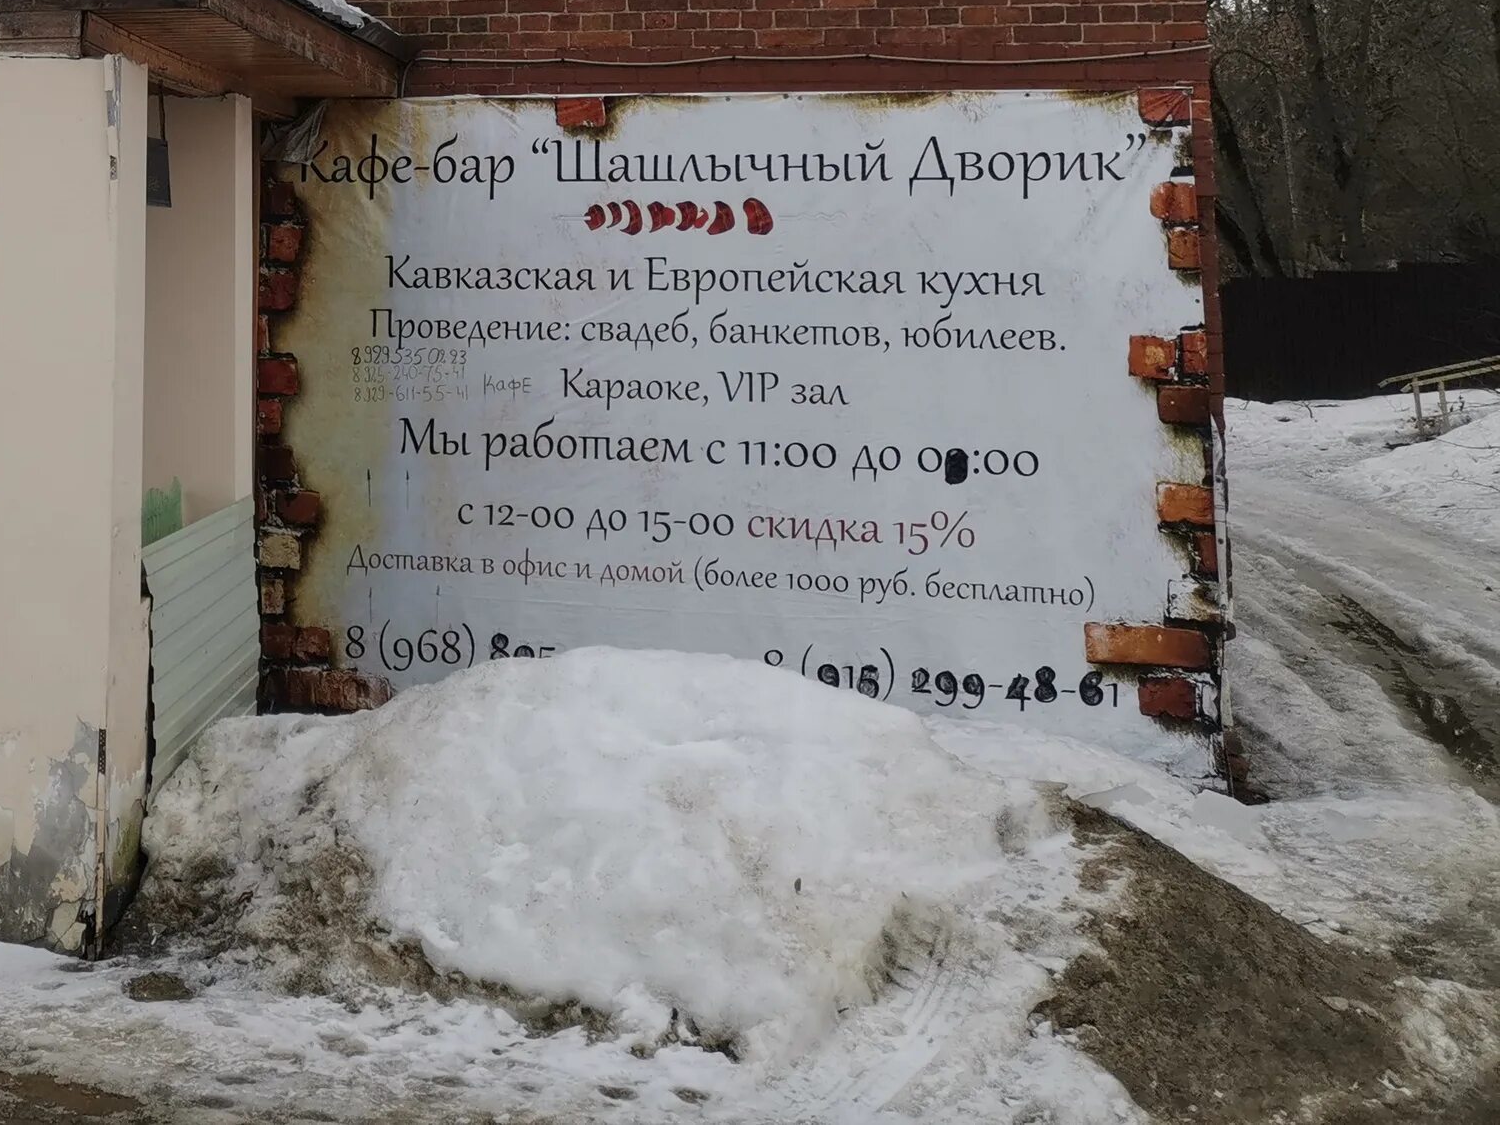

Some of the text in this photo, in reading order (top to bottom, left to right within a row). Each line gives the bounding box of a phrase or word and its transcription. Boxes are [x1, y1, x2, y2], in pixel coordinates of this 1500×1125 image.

[301, 132, 1147, 200] Кафе-бар “Шашлычный Дворик”
[385, 255, 1046, 309] Кавказская и Европейская кухня
[370, 307, 1067, 353] Проведение: свадеб, банкетов, юбилеев.
[560, 367, 850, 410] Караоке, VIP зал
[399, 415, 1040, 485] Мы работаем с 11:00 до 0:00
[457, 503, 976, 556] с 12-00 до 15-00 скидка 15%
[346, 543, 1096, 613] Доставка в офис и домой (более 1000 руб. бесплатно)
[345, 625, 366, 659] 8
[378, 619, 476, 672] (968)
